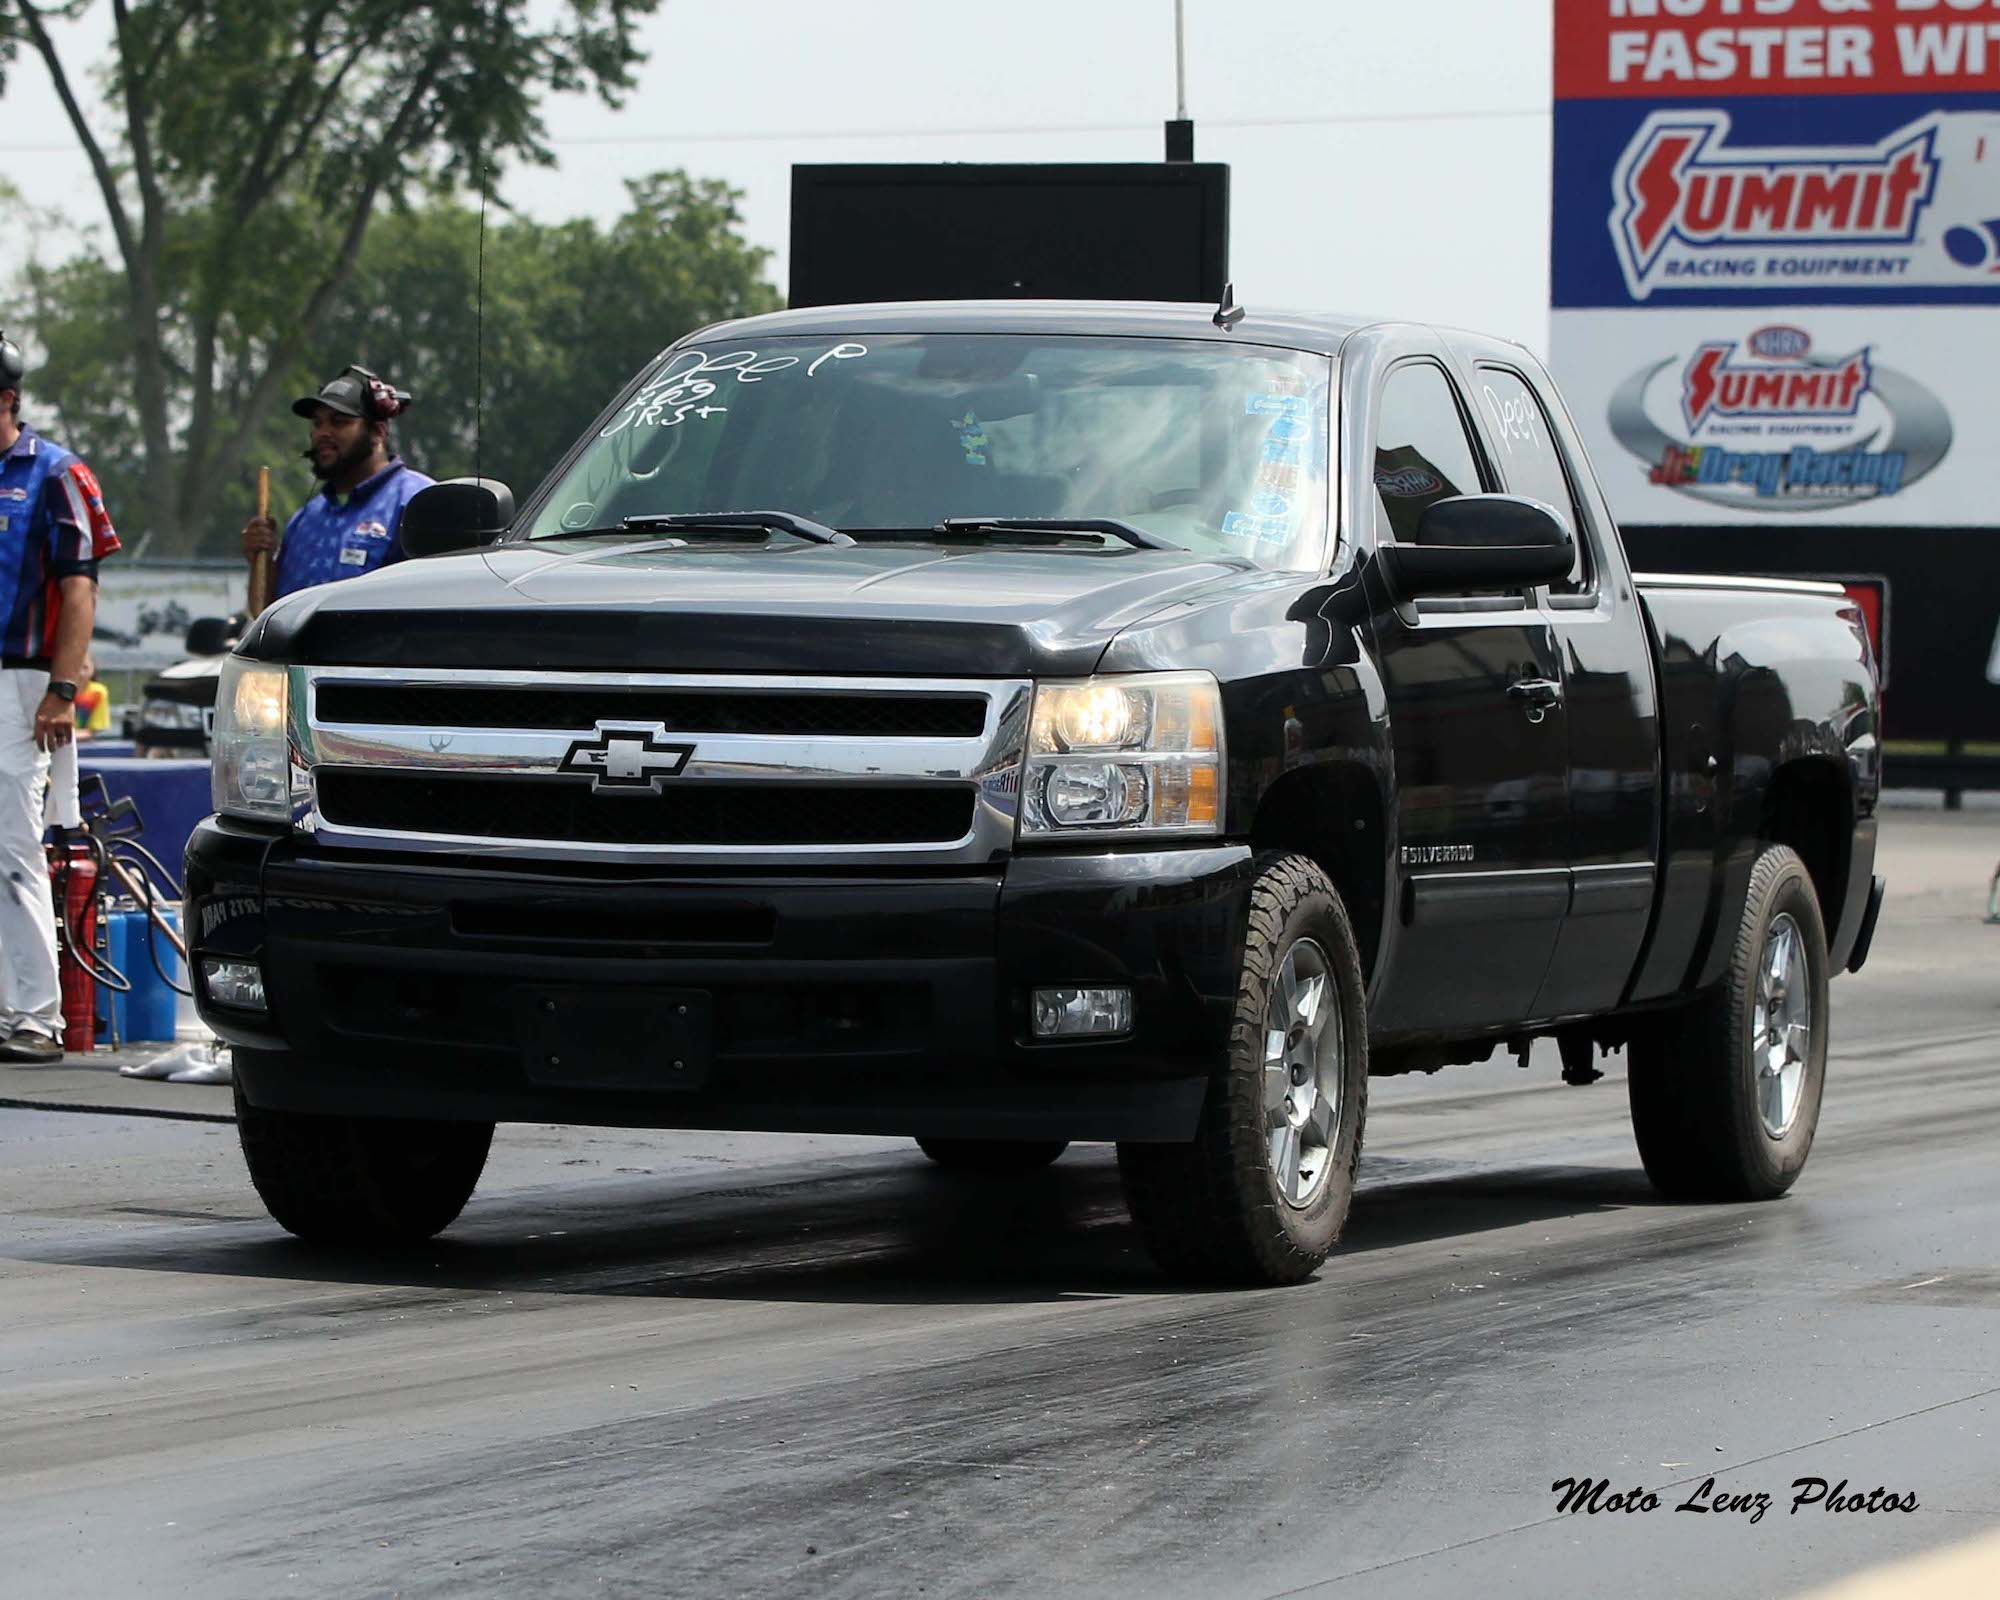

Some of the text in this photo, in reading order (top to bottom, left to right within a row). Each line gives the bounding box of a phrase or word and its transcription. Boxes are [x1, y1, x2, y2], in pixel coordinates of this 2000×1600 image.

[1608, 26, 1874, 82] FASTER
[1664, 257, 1911, 277] RACING EQUIPMENT
[1696, 446, 1781, 496] Drag
[1785, 445, 1906, 496] Racing
[1409, 845, 1475, 864] SILVERADO
